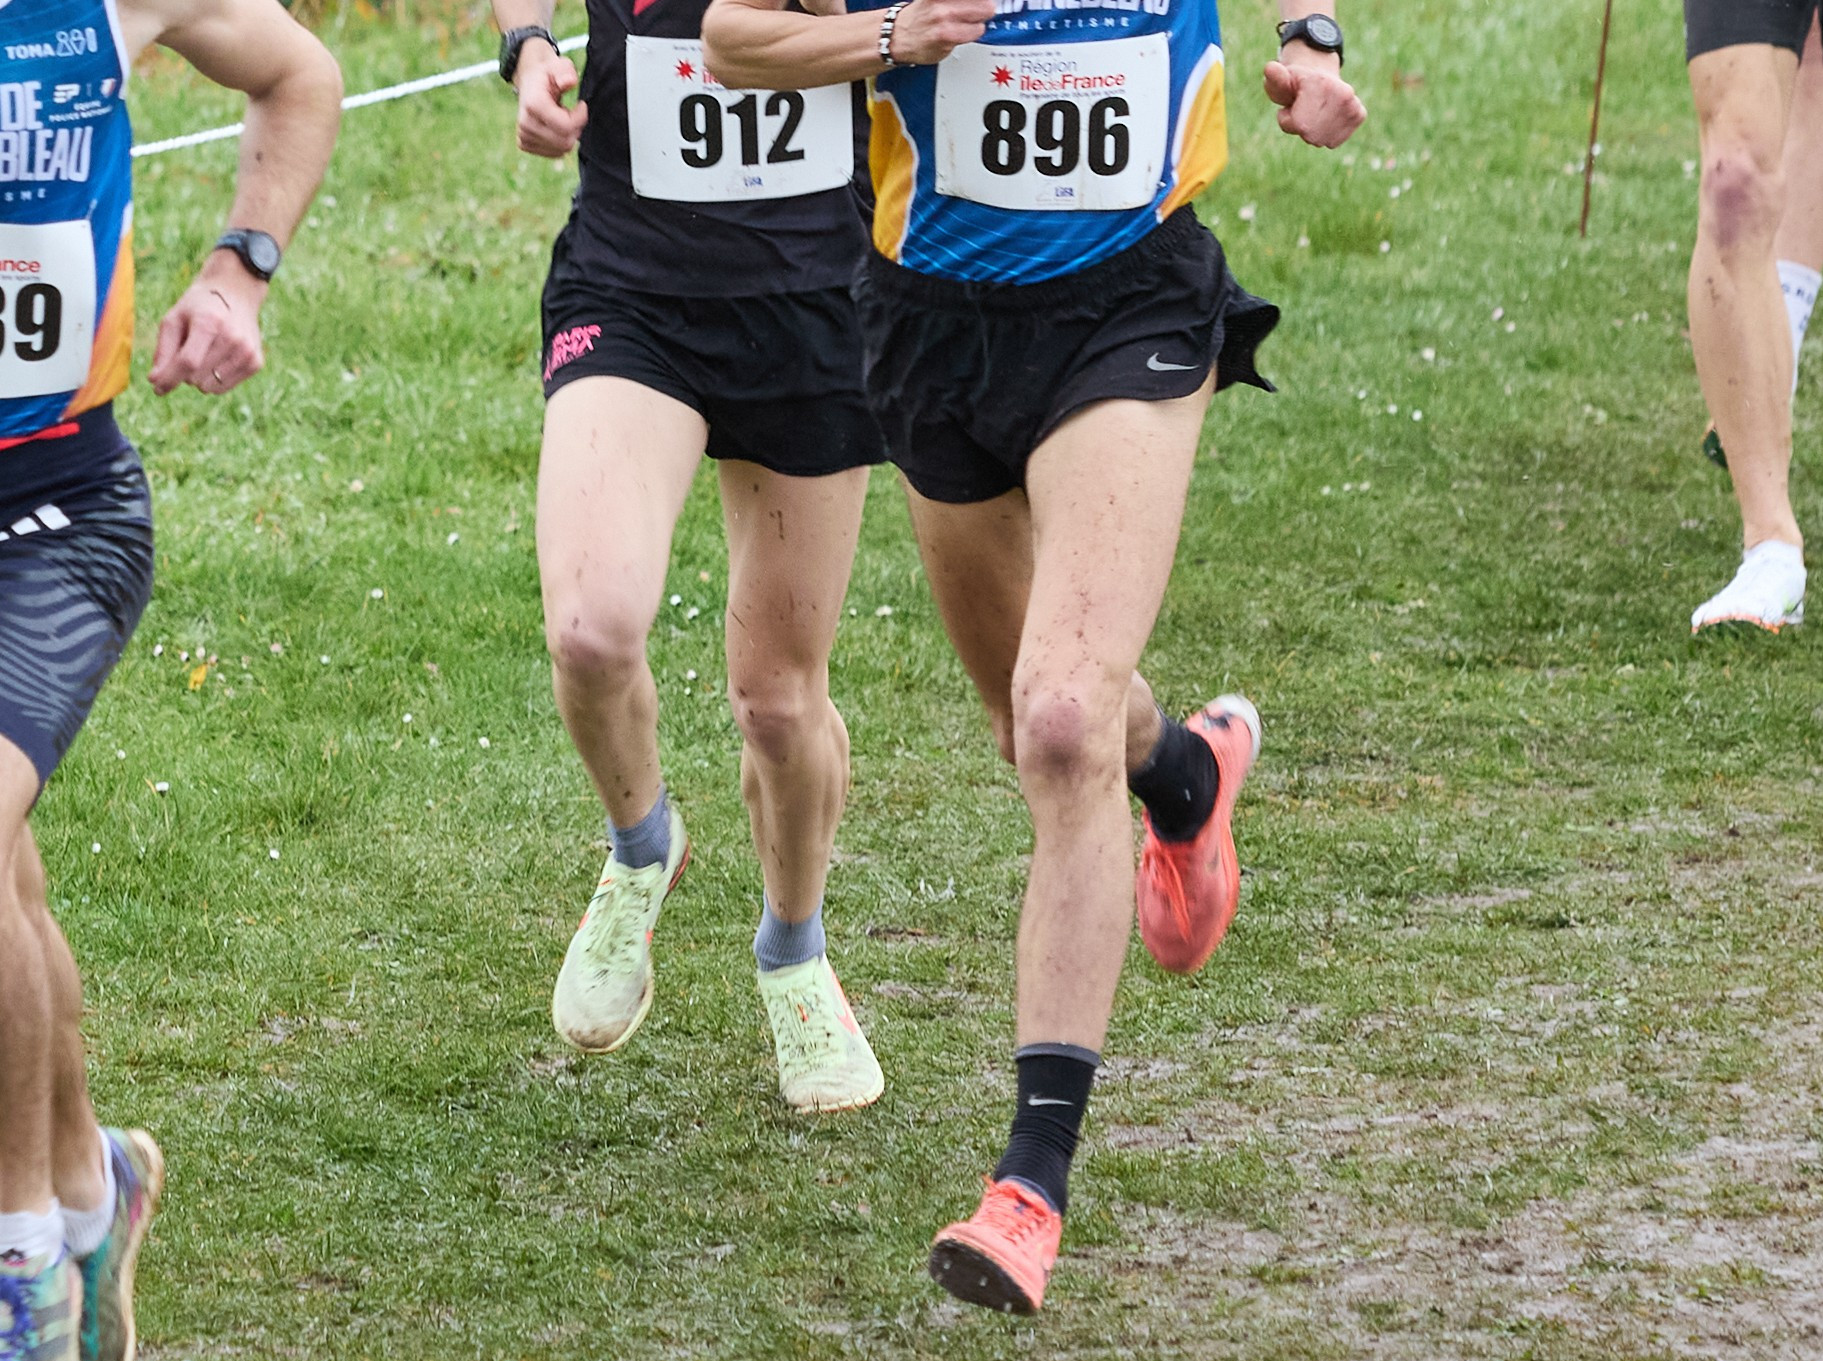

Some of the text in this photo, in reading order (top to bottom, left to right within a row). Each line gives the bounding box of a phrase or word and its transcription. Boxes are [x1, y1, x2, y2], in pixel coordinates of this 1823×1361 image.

[1020, 59, 1077, 76] Région
[679, 91, 805, 168] 912
[981, 96, 1130, 177] 896
